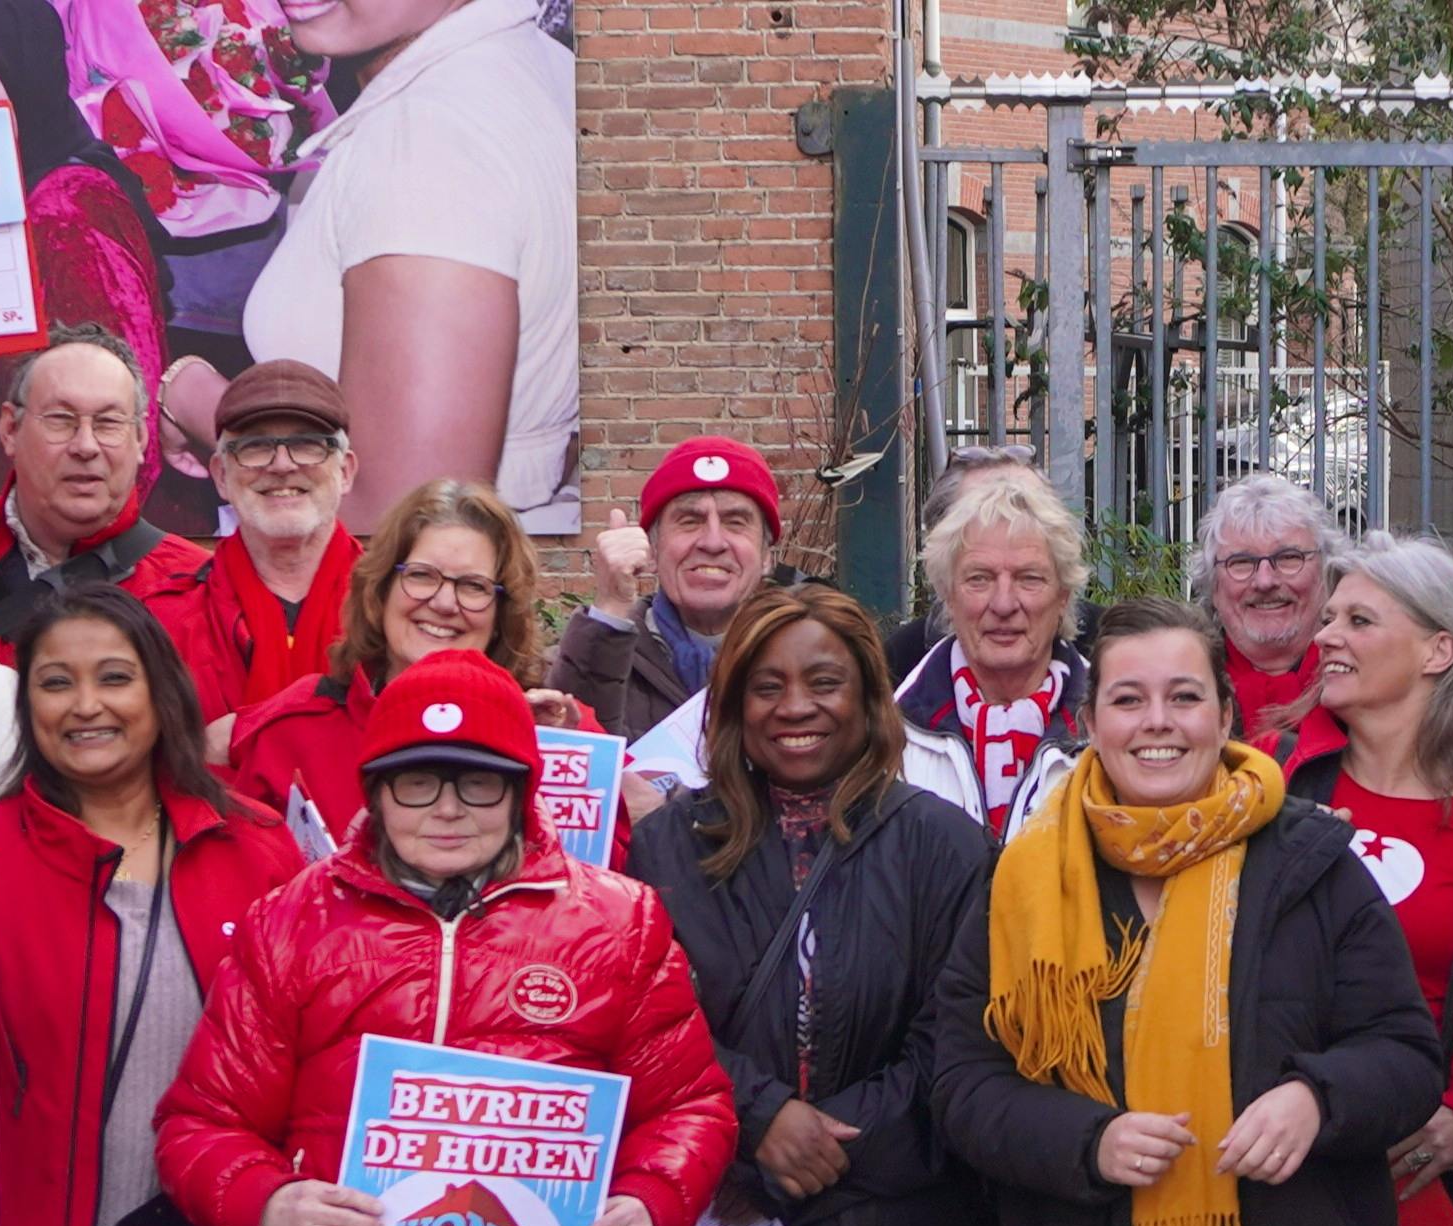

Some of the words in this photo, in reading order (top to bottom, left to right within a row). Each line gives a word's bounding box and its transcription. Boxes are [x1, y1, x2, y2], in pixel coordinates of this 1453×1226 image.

[390, 1082, 587, 1129] BEVRIES
[363, 1130, 427, 1167] DE
[433, 1136, 599, 1178] HUREN
